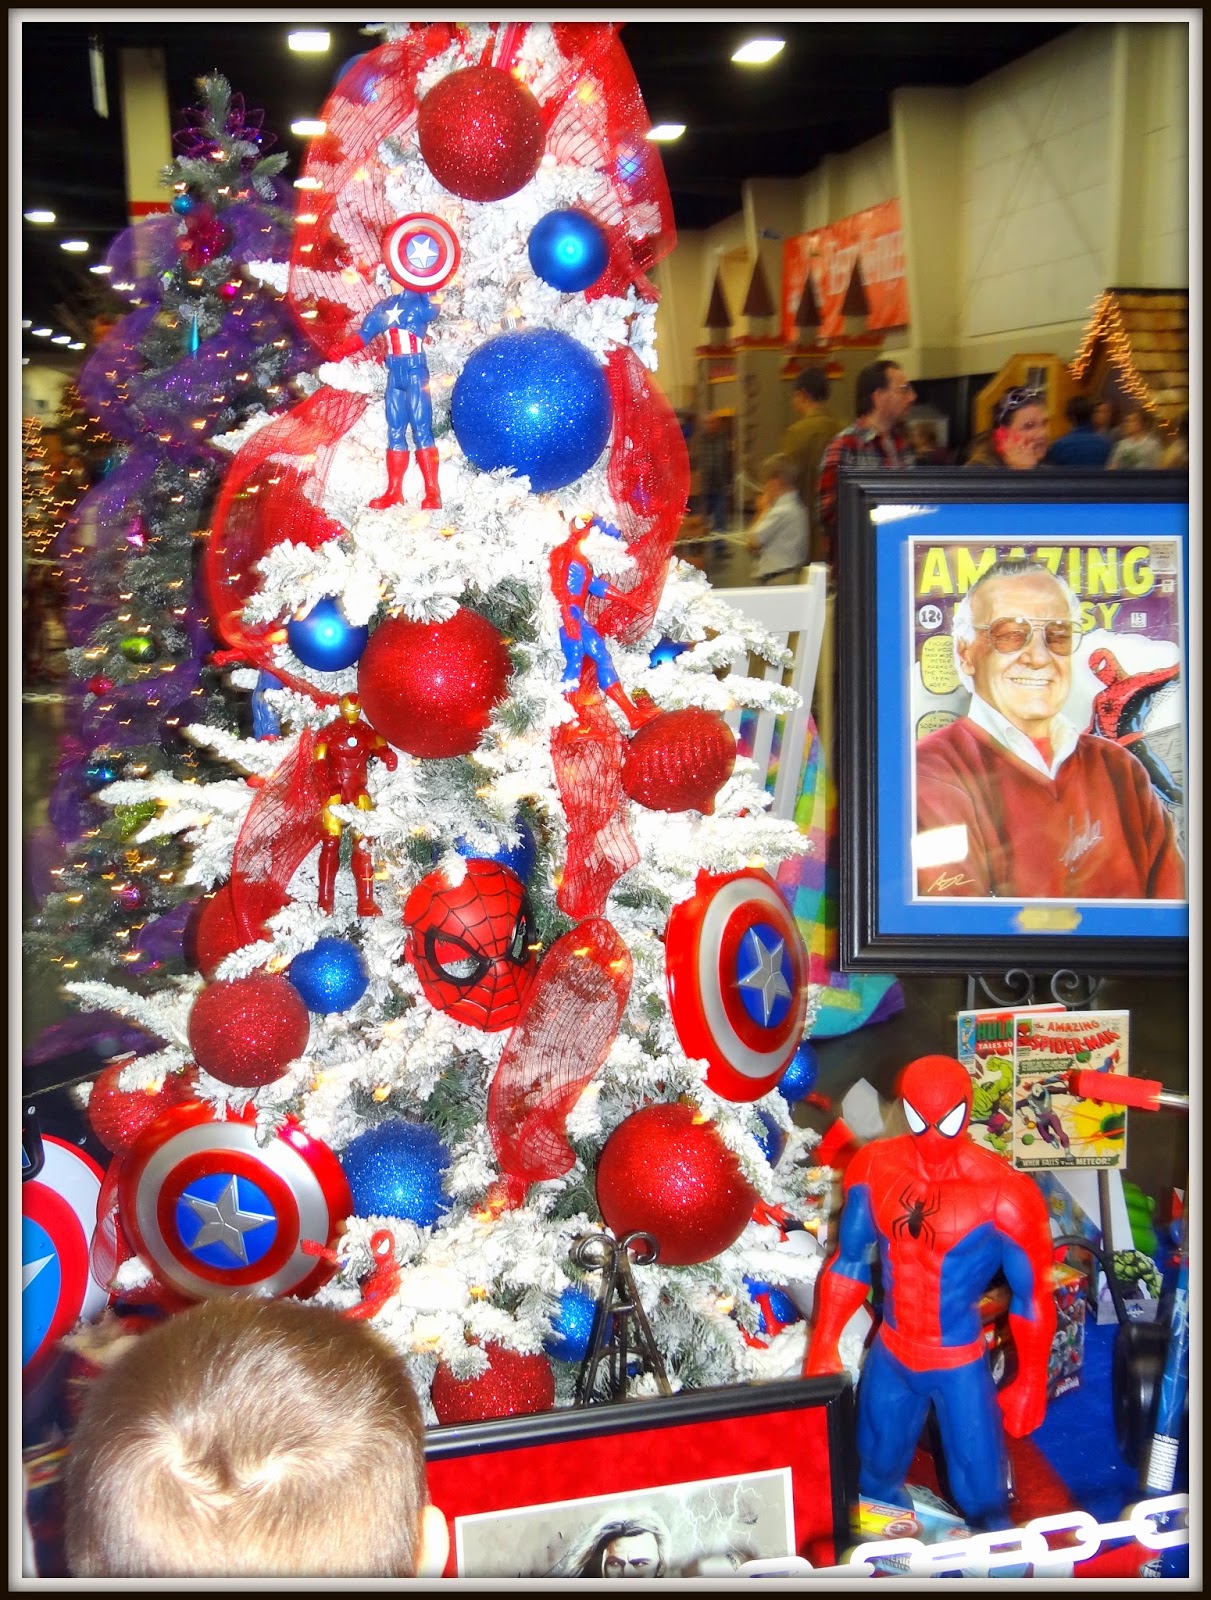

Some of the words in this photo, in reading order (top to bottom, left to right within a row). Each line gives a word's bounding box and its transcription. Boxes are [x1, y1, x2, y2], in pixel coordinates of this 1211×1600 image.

[920, 547, 1155, 595] AMZING
[1048, 1020, 1100, 1032] AMAZING
[979, 1041, 1002, 1049] TALES
[1031, 1029, 1120, 1055] SPIDER-MAN
